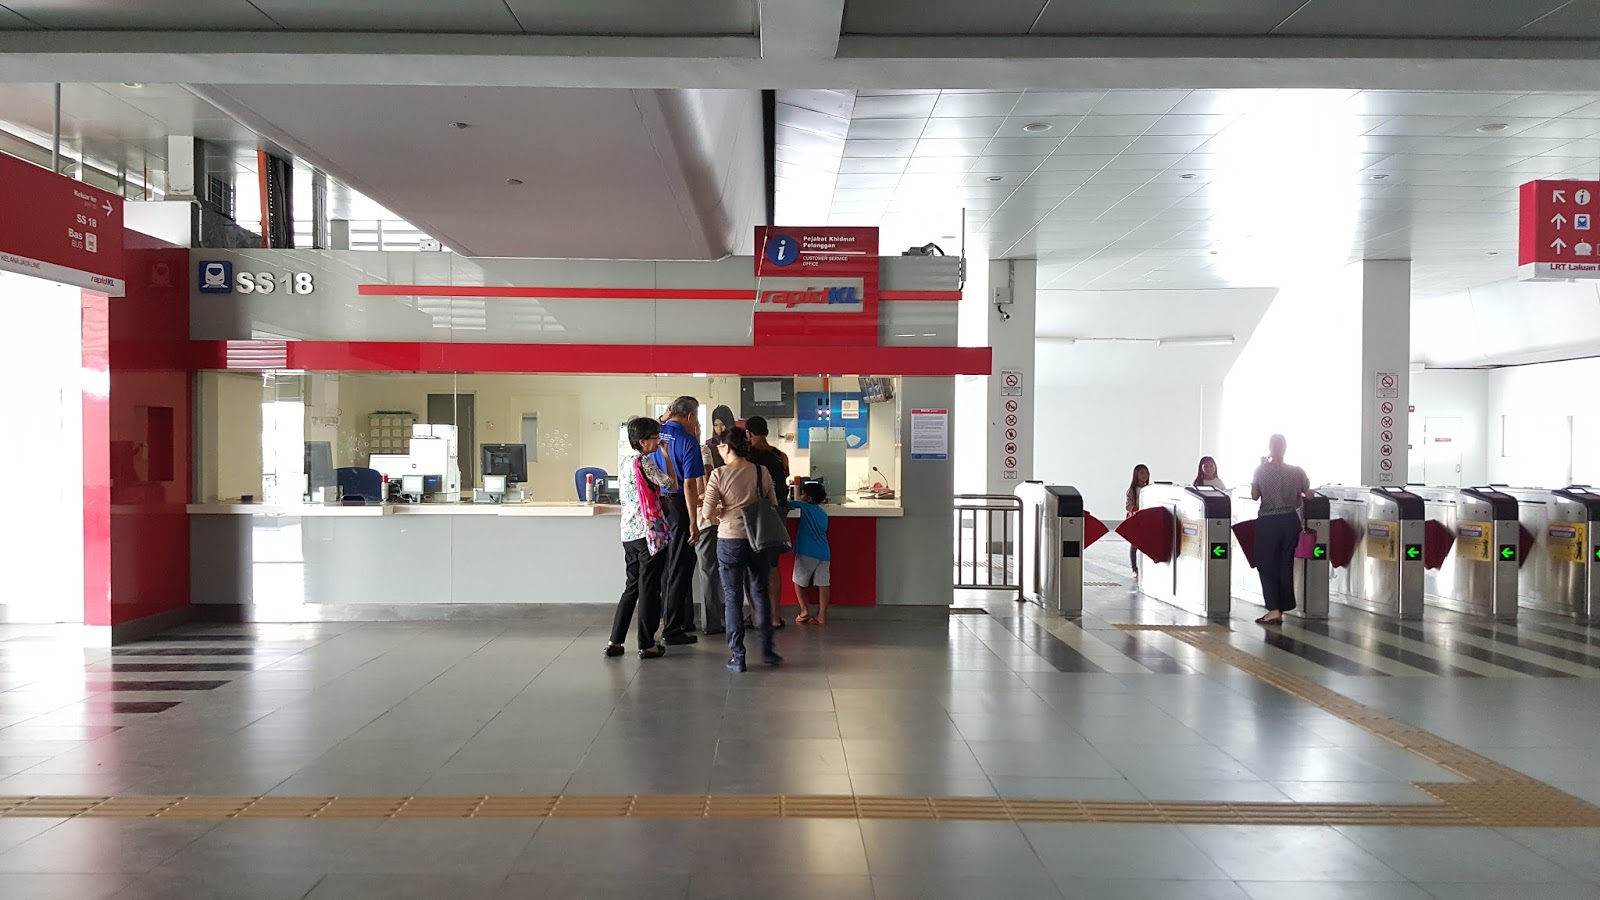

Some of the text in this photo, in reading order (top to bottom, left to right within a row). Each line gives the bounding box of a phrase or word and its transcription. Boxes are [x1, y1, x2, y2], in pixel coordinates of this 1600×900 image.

[76, 213, 97, 228] SS 18
[68, 227, 83, 240] Bas
[803, 235, 828, 243] Pejabat
[71, 239, 83, 249] BUS
[1550, 263, 1566, 271] LRT
[1569, 264, 1596, 272] Laluan
[235, 272, 314, 295] SS 18
[760, 286, 862, 308] rapidKL
